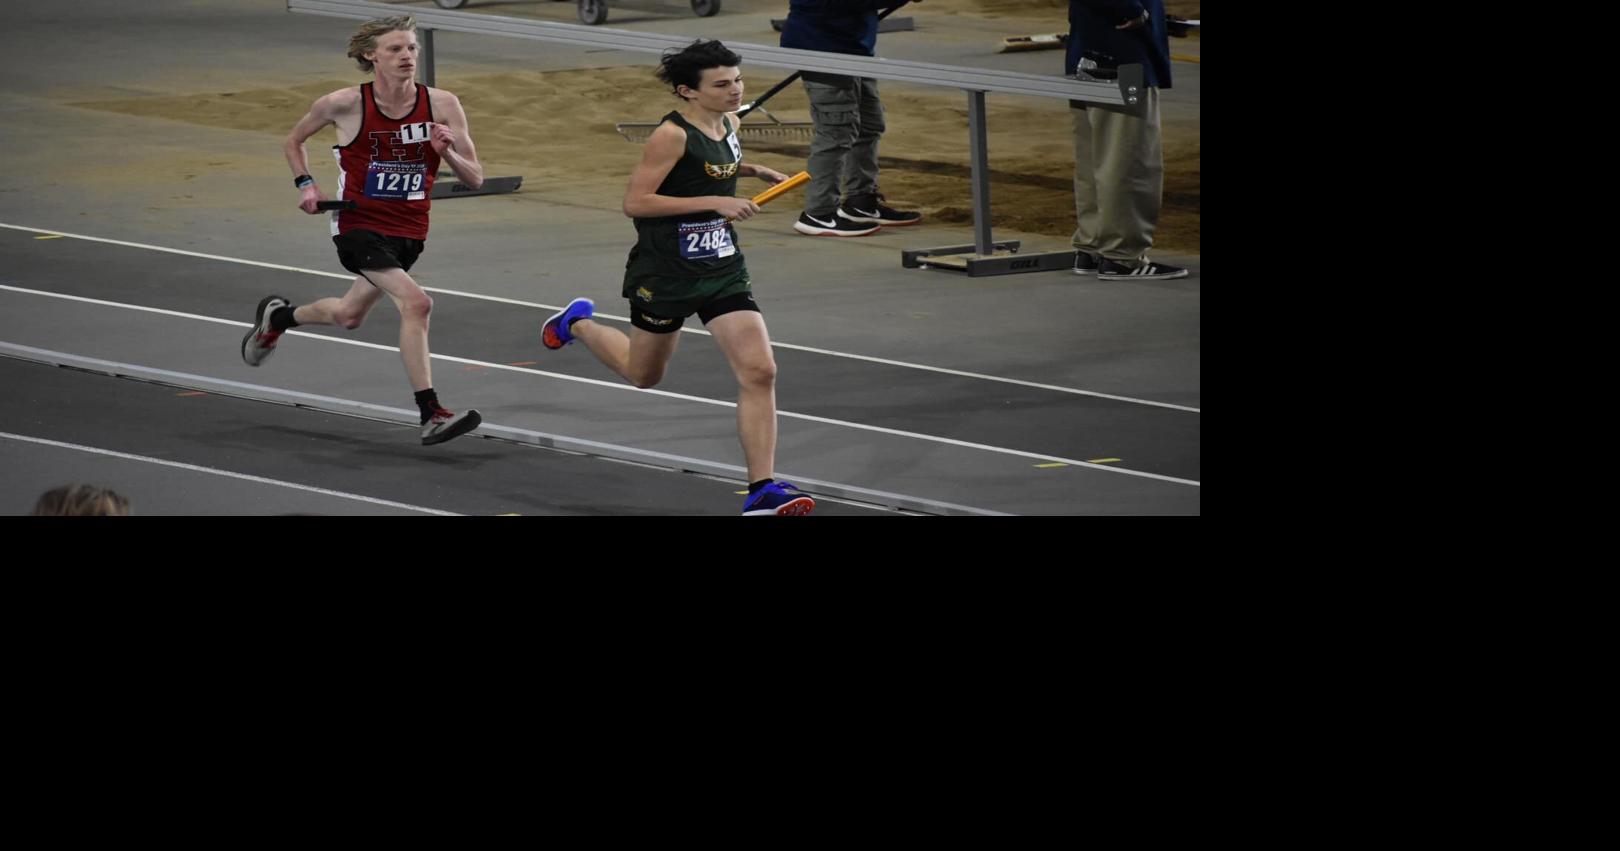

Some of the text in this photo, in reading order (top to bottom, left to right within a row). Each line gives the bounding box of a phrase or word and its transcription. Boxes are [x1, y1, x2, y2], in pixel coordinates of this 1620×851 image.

[403, 122, 428, 141] 11
[376, 172, 422, 191] 1219
[687, 228, 727, 252] 2482
